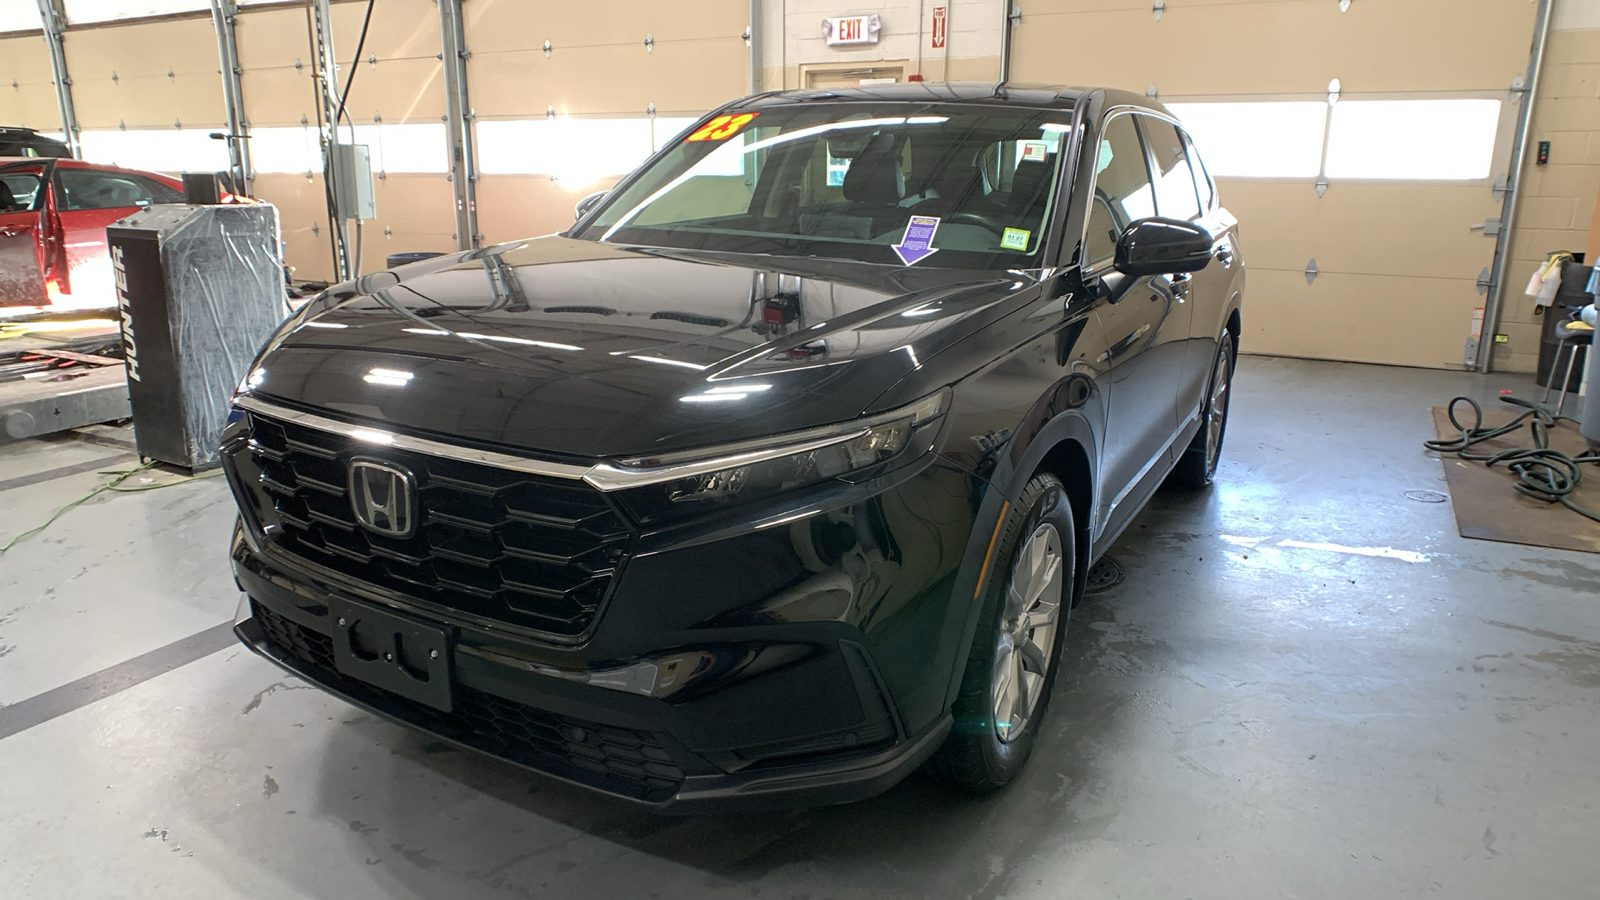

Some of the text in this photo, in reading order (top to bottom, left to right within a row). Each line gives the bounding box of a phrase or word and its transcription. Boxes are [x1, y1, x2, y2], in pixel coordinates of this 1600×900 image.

[839, 18, 862, 41] EXIT
[687, 113, 753, 141] 23
[112, 245, 141, 383] HUNTER
